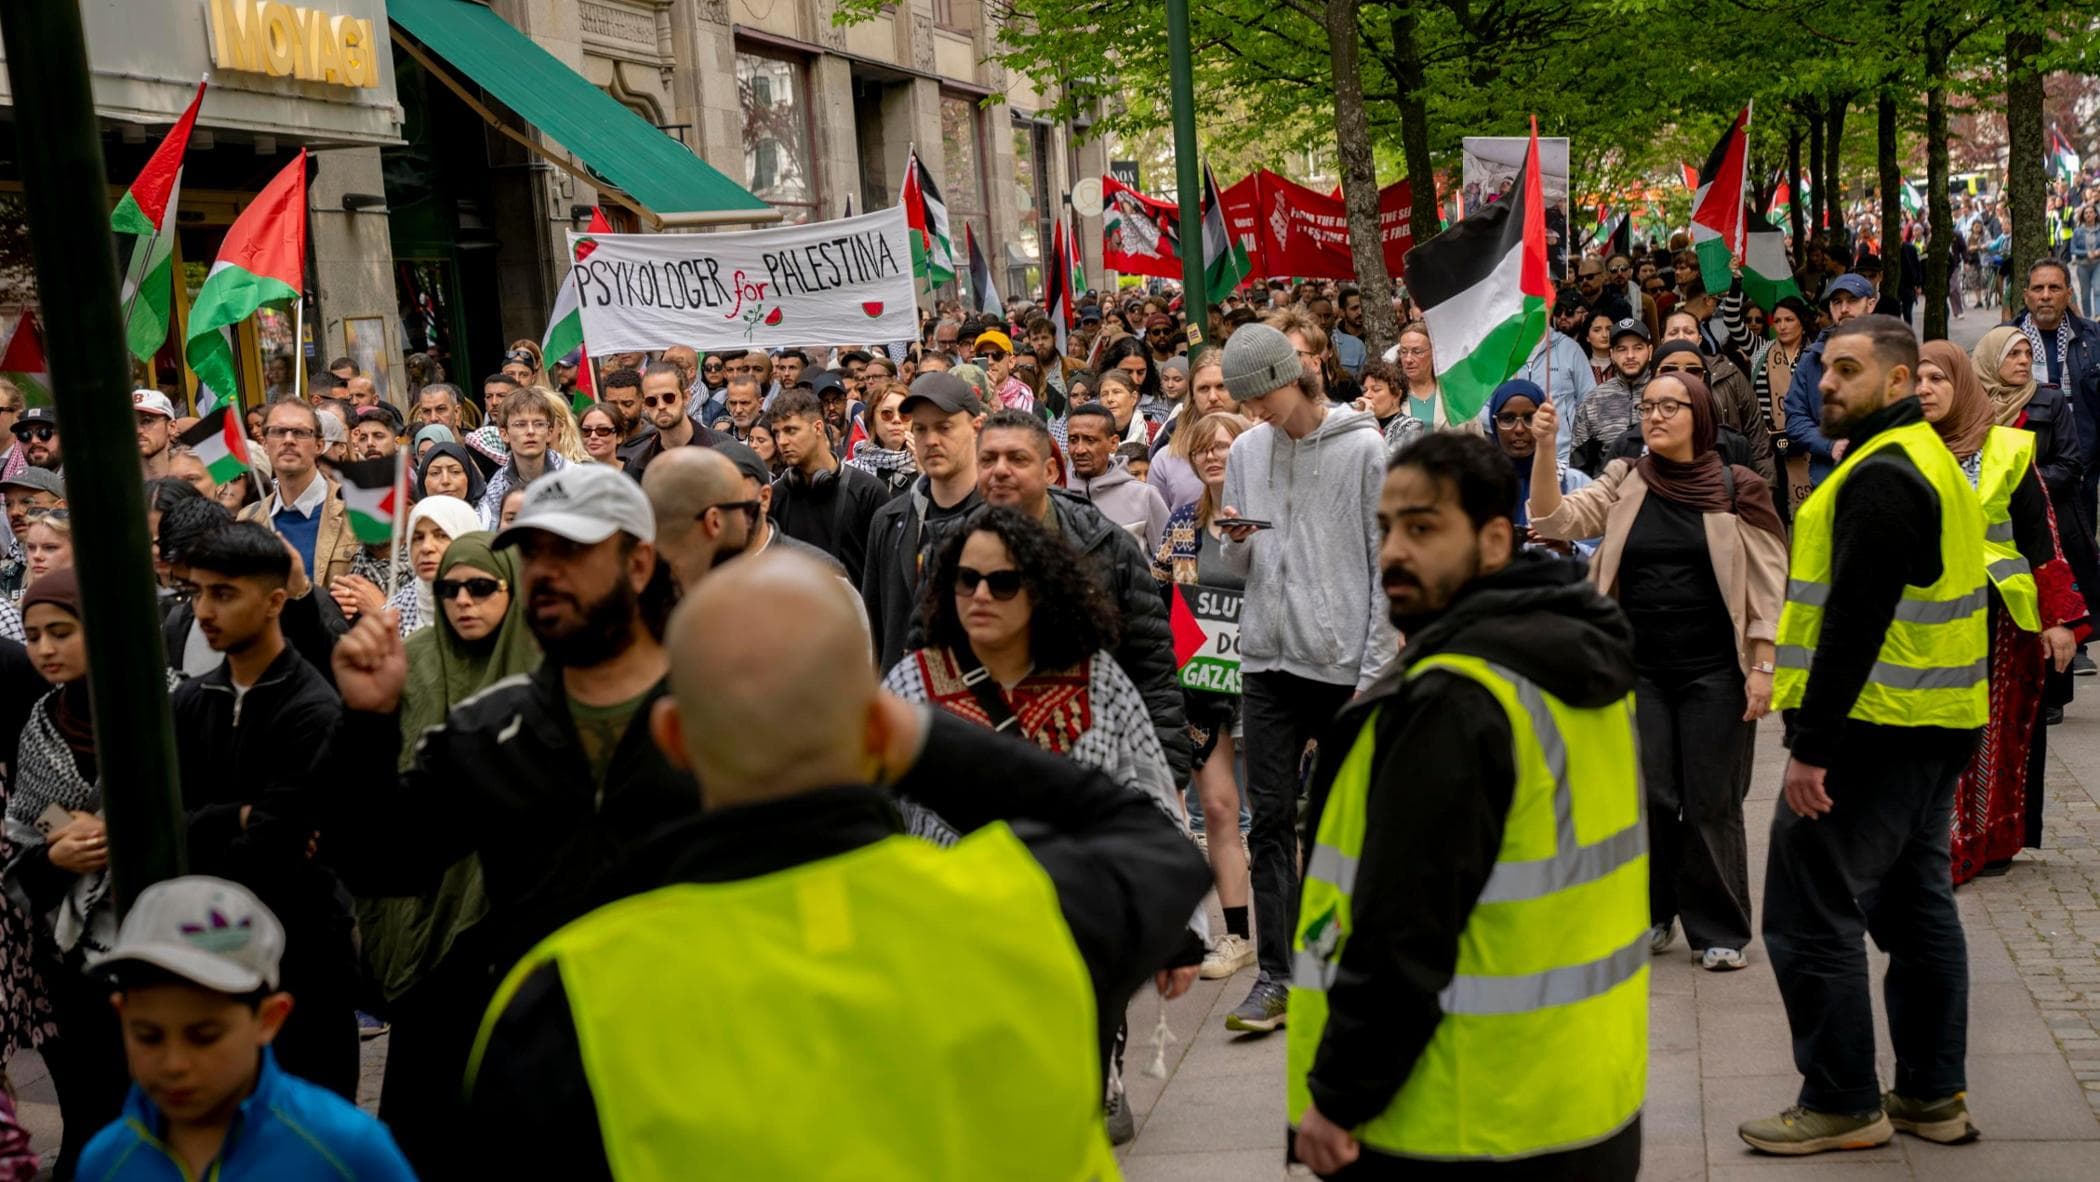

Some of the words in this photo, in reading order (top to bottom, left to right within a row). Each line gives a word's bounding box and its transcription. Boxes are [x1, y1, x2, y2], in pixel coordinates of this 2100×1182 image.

[210, 0, 380, 88] MOYAGI
[1316, 215, 1335, 226] THE
[1381, 211, 1398, 224] THE
[573, 258, 731, 309] PSYKOLOGER
[763, 231, 899, 297] PALESTINA
